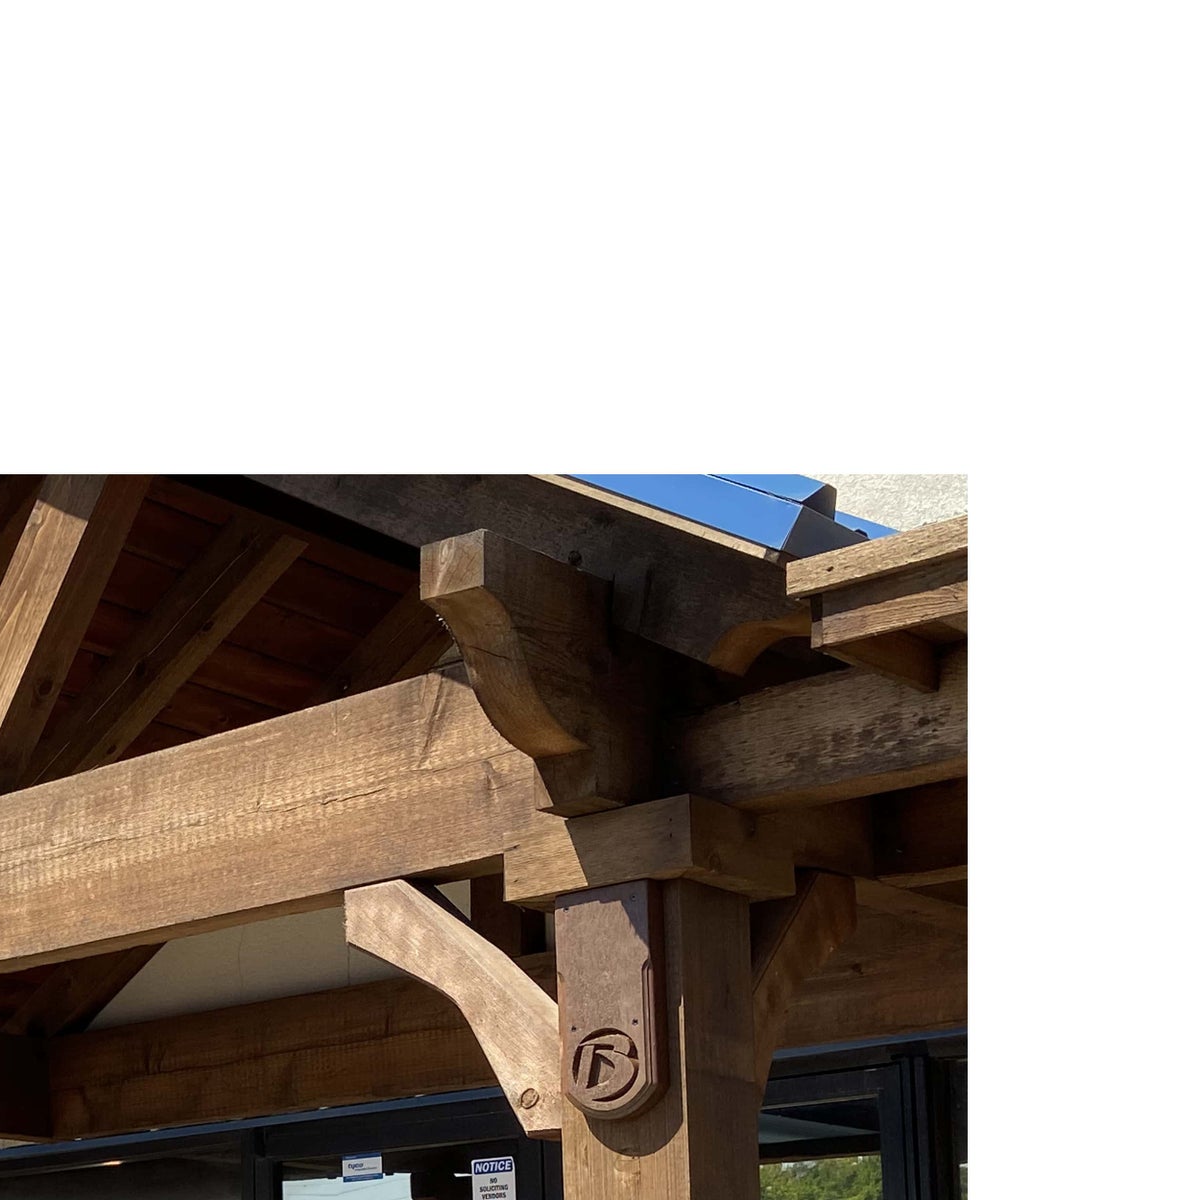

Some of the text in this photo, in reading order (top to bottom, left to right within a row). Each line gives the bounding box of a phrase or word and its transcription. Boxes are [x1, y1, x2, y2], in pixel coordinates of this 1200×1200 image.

[475, 1160, 512, 1173] NOTICE
[479, 1184, 509, 1192] SOLICITING
[481, 1192, 507, 1200] VENDORS
